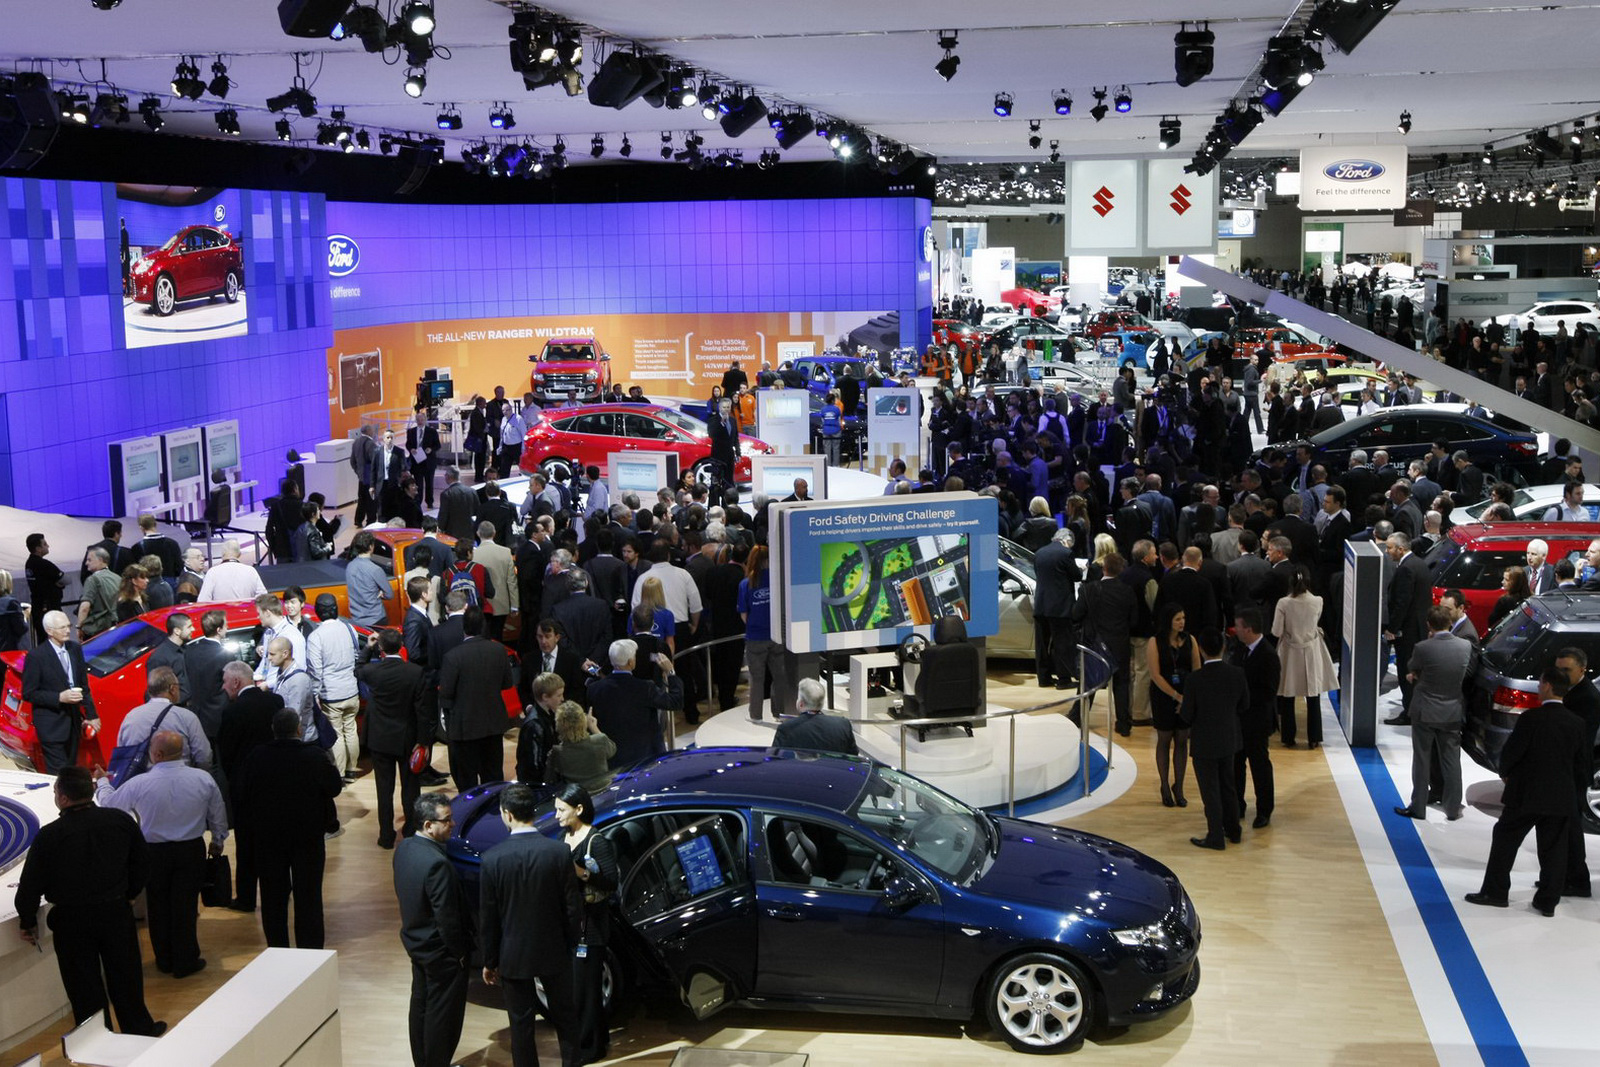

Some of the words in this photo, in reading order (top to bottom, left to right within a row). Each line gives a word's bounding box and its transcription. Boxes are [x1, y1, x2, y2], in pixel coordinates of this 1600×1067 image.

[1335, 163, 1372, 178] Ford
[1351, 187, 1391, 195] difference
[328, 241, 354, 268] Ford
[333, 286, 360, 298] difference
[427, 333, 444, 343] THE
[445, 331, 486, 342] ALL-NEW
[488, 329, 533, 339] RANGER
[535, 326, 595, 337] WILDTRAK
[809, 516, 832, 526] Ford
[834, 514, 867, 525] Safety
[869, 512, 904, 522] Driving
[906, 509, 956, 519] Challenge
